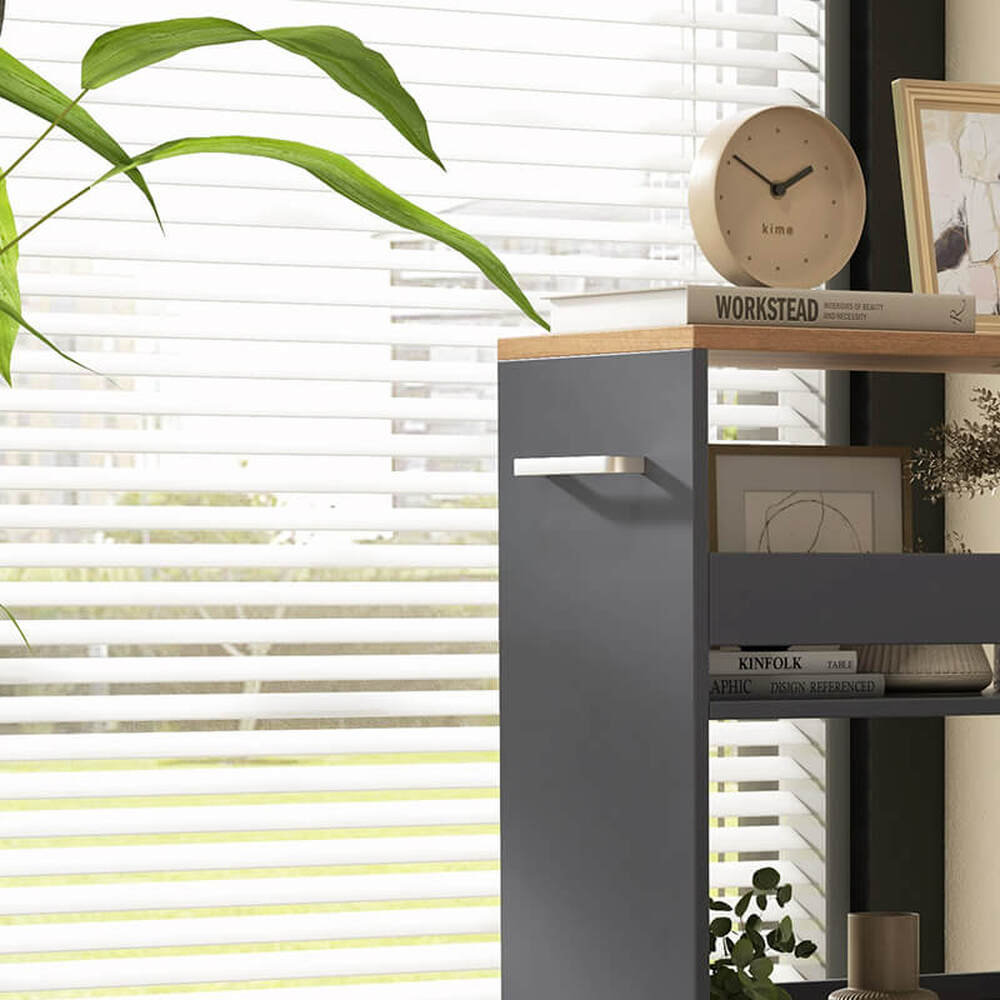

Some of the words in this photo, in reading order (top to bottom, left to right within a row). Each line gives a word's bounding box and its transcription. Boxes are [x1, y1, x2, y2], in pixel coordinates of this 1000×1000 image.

[761, 221, 794, 236] kime
[715, 294, 819, 322] WORKSTEAD
[738, 656, 803, 671] KINFOLK
[711, 678, 752, 695] APHIC
[809, 679, 876, 694] REFERENCED
